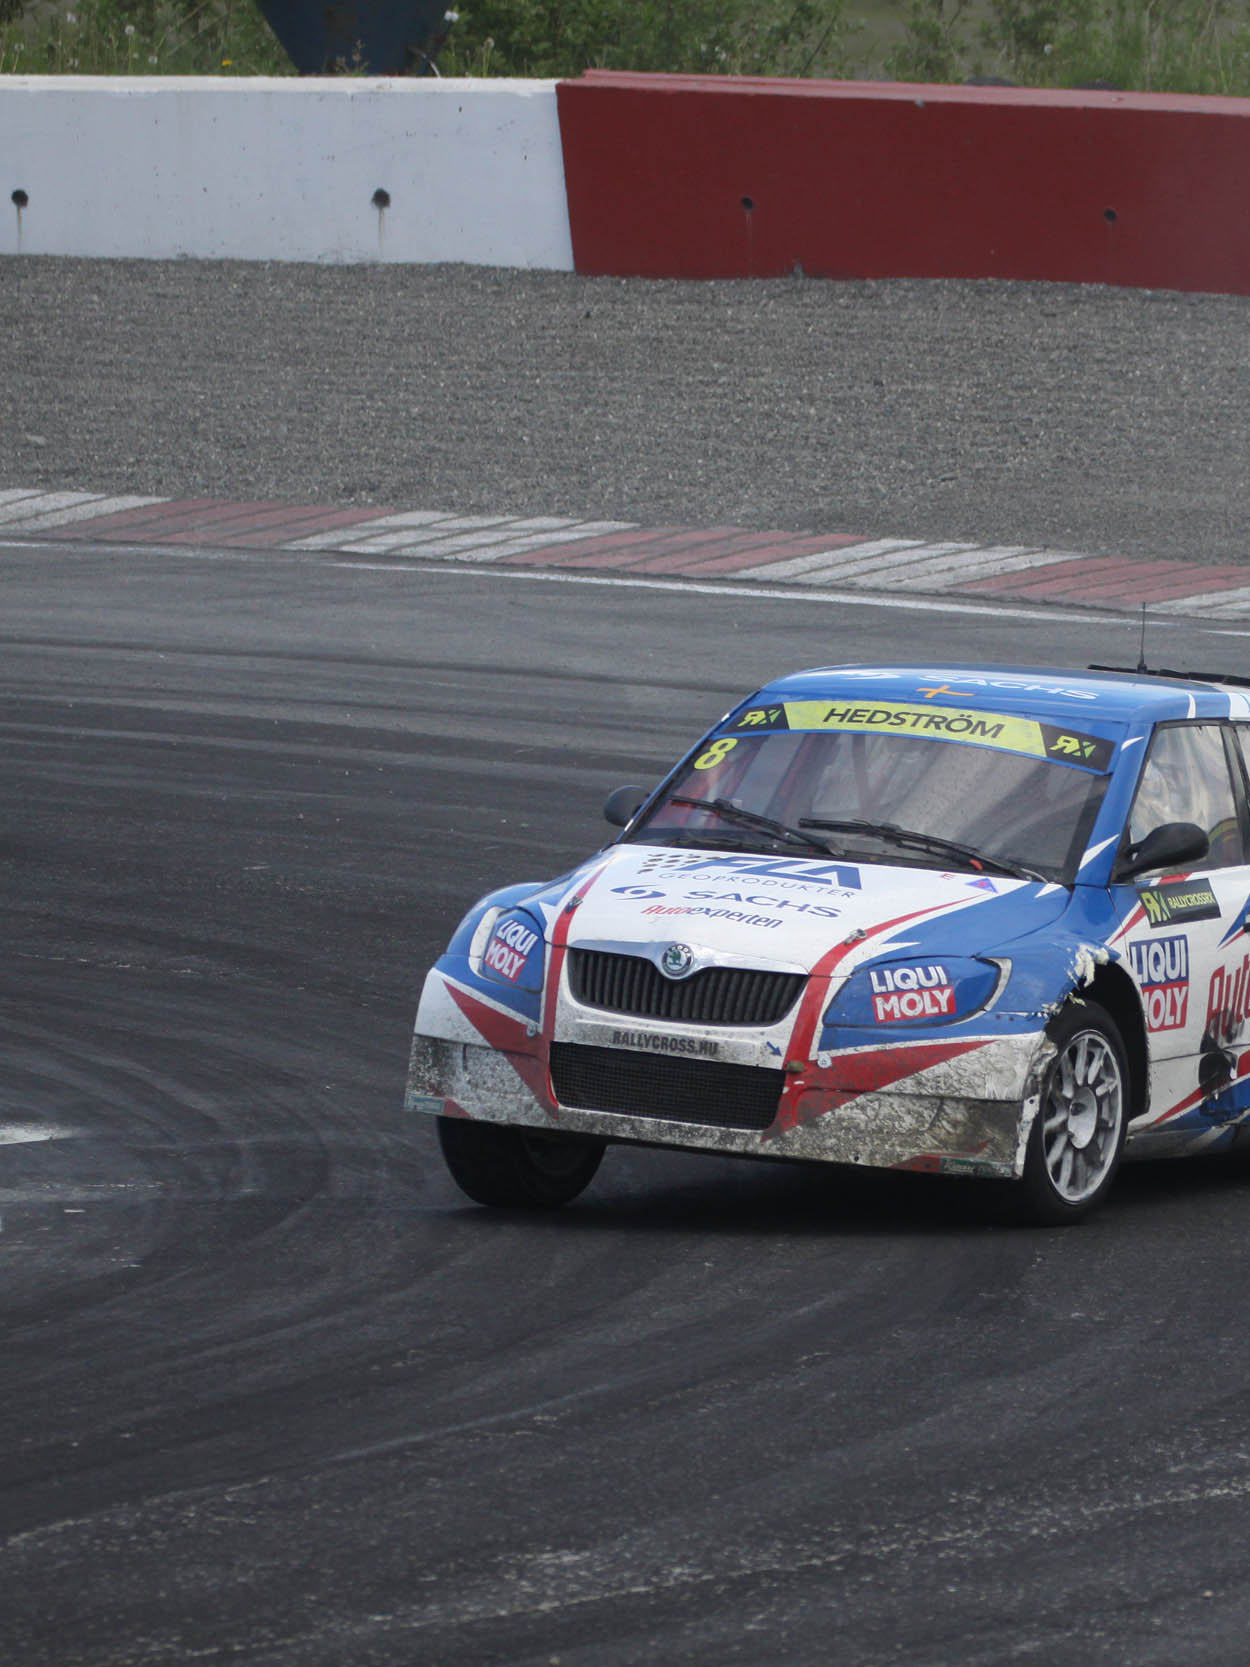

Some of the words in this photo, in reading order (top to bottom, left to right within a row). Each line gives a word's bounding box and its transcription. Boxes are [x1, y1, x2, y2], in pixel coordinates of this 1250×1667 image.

[919, 675, 1099, 700] SACHS
[823, 708, 1006, 739] HEDSTRÖM
[694, 738, 738, 770] 8
[658, 872, 856, 898] GEOPRODUKTER
[683, 890, 842, 918] SACHS
[497, 920, 538, 956] LIQUI
[485, 940, 525, 978] MOLY
[1130, 939, 1187, 984] LIQUI
[870, 966, 948, 993] LIQUI
[875, 989, 952, 1020] MOLY
